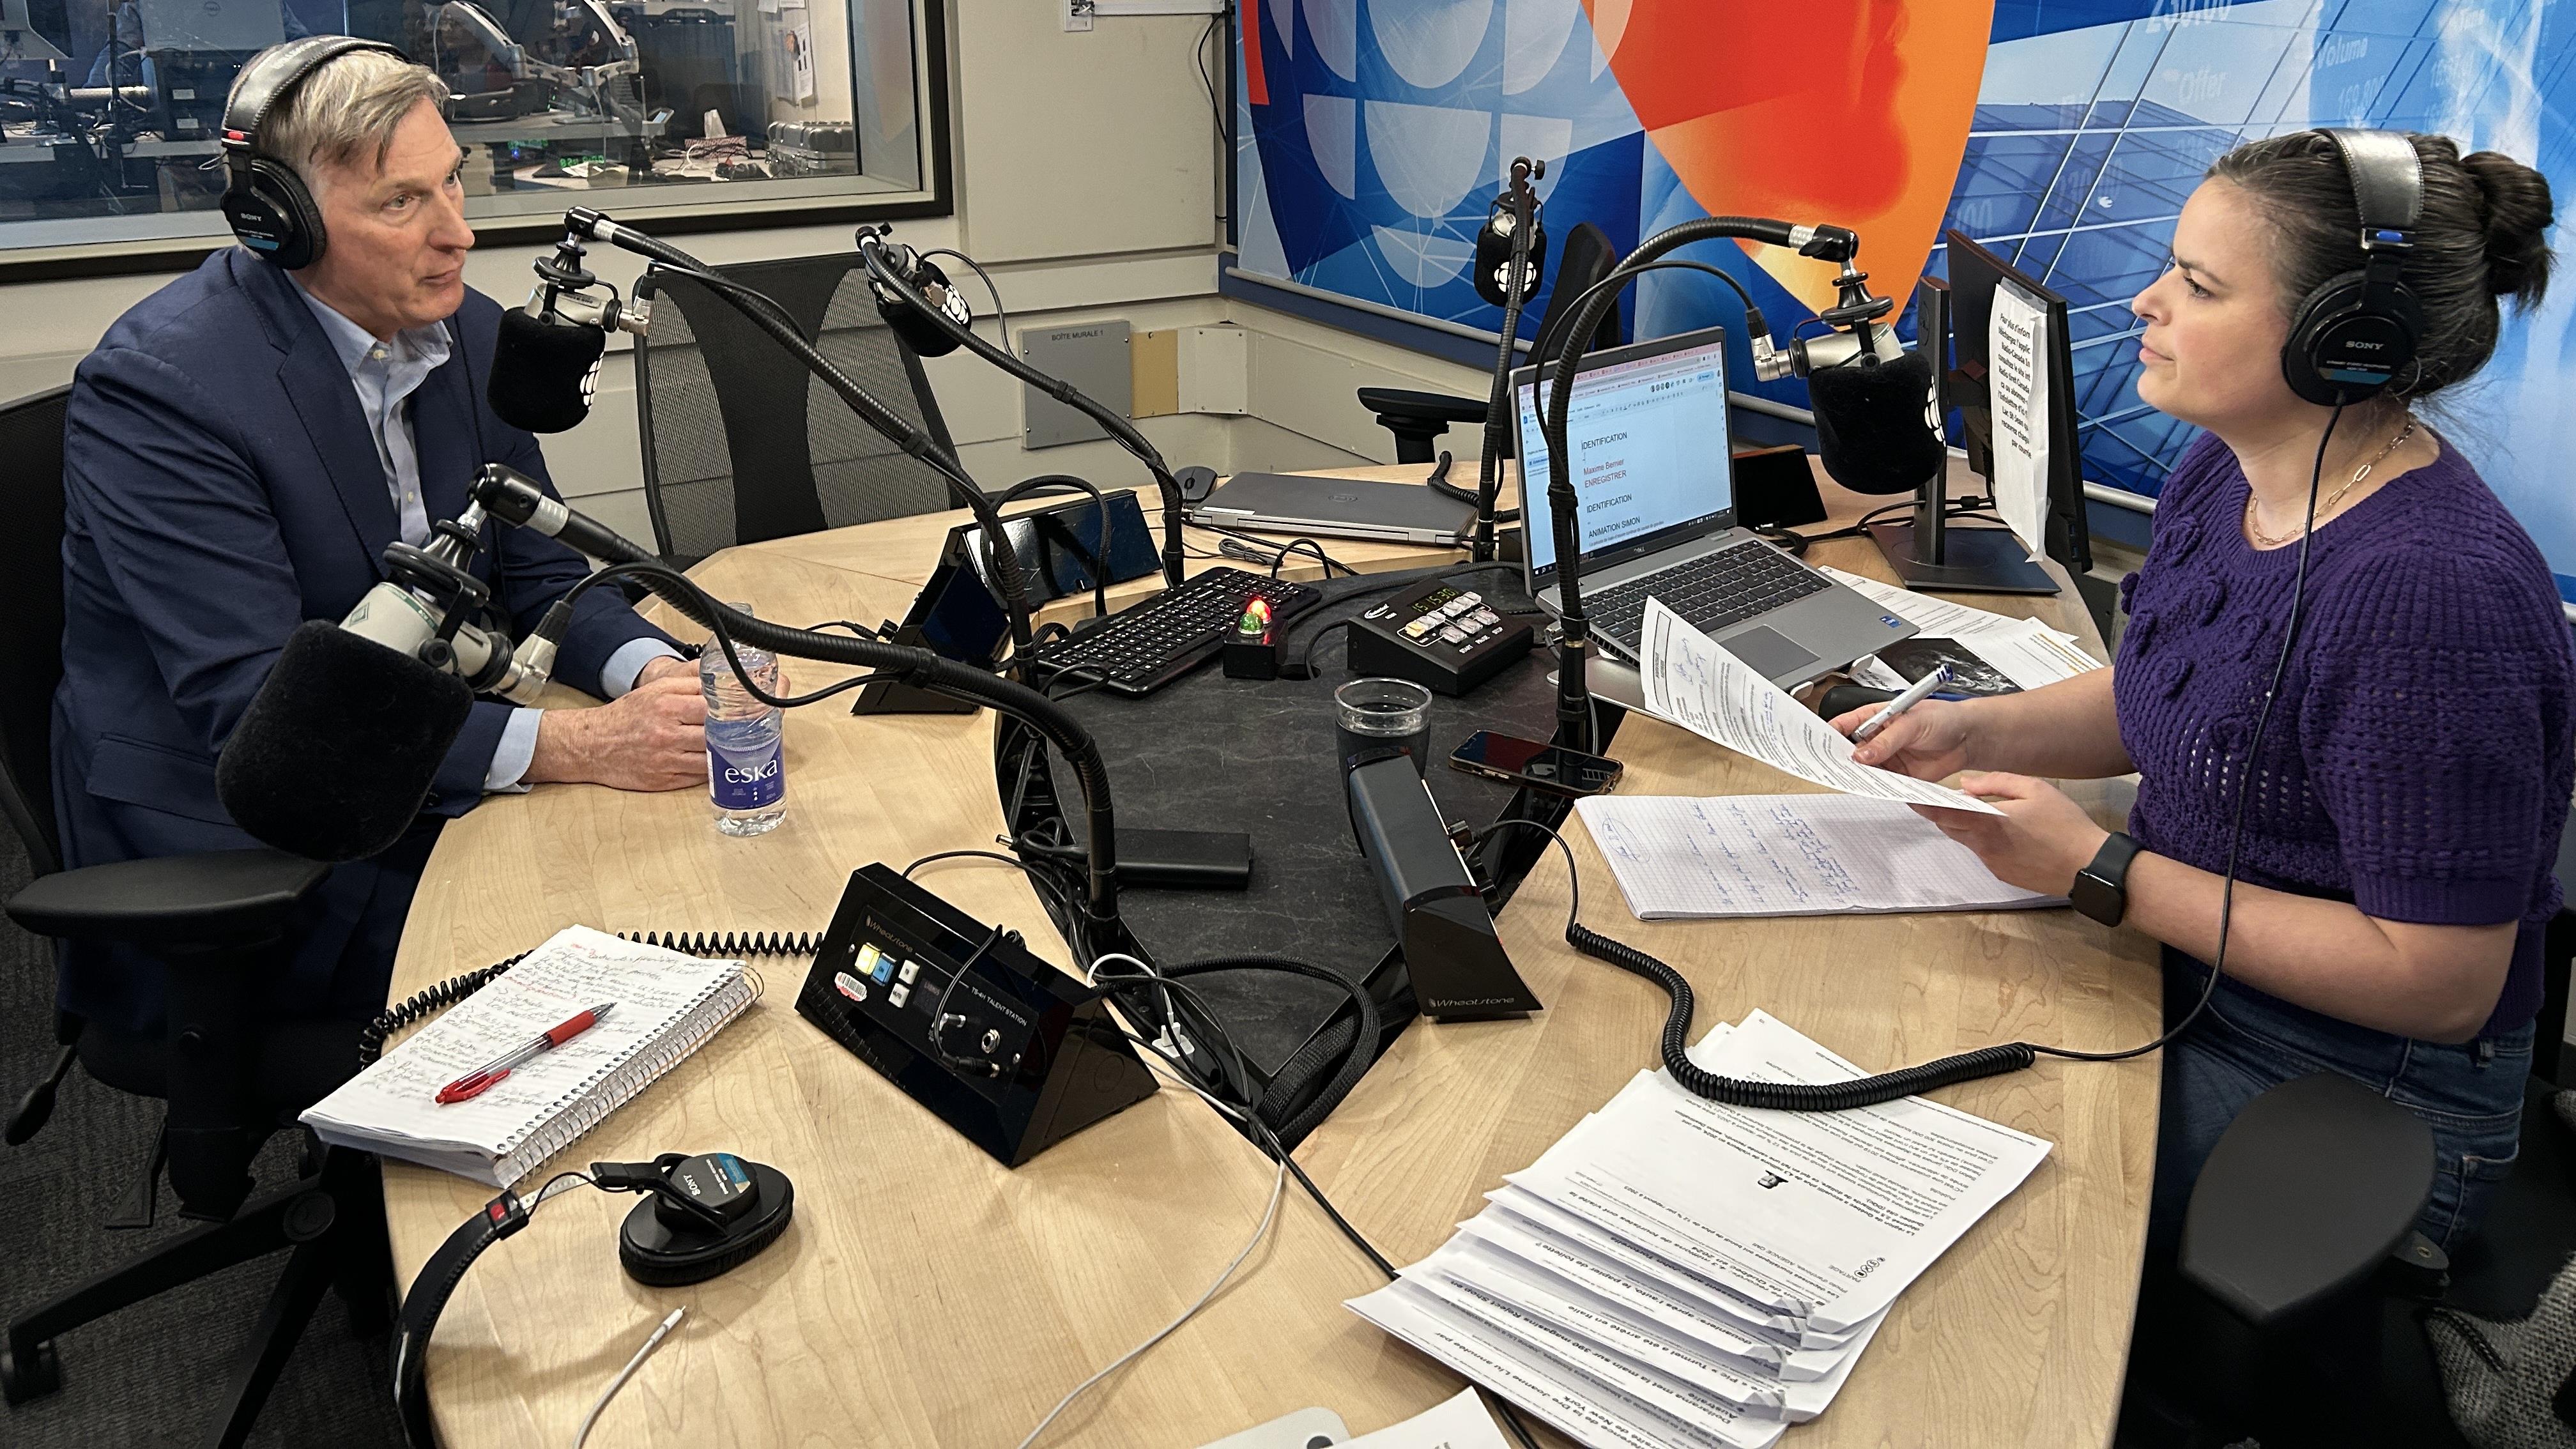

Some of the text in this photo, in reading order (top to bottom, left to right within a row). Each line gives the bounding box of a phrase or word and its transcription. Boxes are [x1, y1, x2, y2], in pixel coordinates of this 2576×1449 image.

[2317, 36, 2368, 70] Volume
[2345, 341, 2385, 350] SONY
[1582, 432, 1627, 450] IDENTIFICATION
[1584, 459, 1625, 475] Maxime Bernier
[1584, 470, 1627, 488] ENREGISTRER
[1587, 494, 1632, 513] IDENTIFICATION
[1589, 523, 1620, 538] ANIMATION
[1621, 516, 1640, 528] SIMON
[724, 759, 778, 784] eska
[870, 920, 913, 953] Wheatstone
[1436, 997, 1515, 1008] Wheatstone
[987, 996, 1007, 1012] TALENT
[1006, 1009, 1027, 1027] STATION
[684, 1174, 701, 1196] SONY
[1816, 1186, 1844, 1201] accueilli
[1848, 1202, 1876, 1216] Québec
[1851, 1197, 1882, 1213] milliards
[1883, 1220, 1906, 1232] région
[1898, 1214, 1925, 1227] Québec
[1723, 1237, 1744, 1248] bondi
[1751, 1242, 1766, 1250] QMI
[1574, 1260, 1589, 1269] de
[1754, 1253, 1794, 1275] touristiques
[1765, 1250, 1795, 1266] AGENCE
[1589, 1267, 1621, 1284] papier
[1728, 1264, 1767, 1284] Québec
[1827, 1264, 1862, 1282] PARTAGE
[1825, 1289, 1841, 1298] Les
[1567, 1305, 1593, 1319] Italie
[1665, 1303, 1694, 1319] après
[1594, 1317, 1608, 1326] en
[1609, 1324, 1641, 1340] arrêté
[1448, 1280, 1731, 1424] Dollarama met la main sur 390 magasins Reject Shop en
[1669, 1350, 1708, 1370] Turmel
[1434, 1331, 1600, 1425] de la Dre Joanne Liu annulée par
[1719, 1372, 1738, 1383] Pic
[1686, 1392, 1738, 1420] Australie
[1561, 1395, 1629, 1434] de New York
